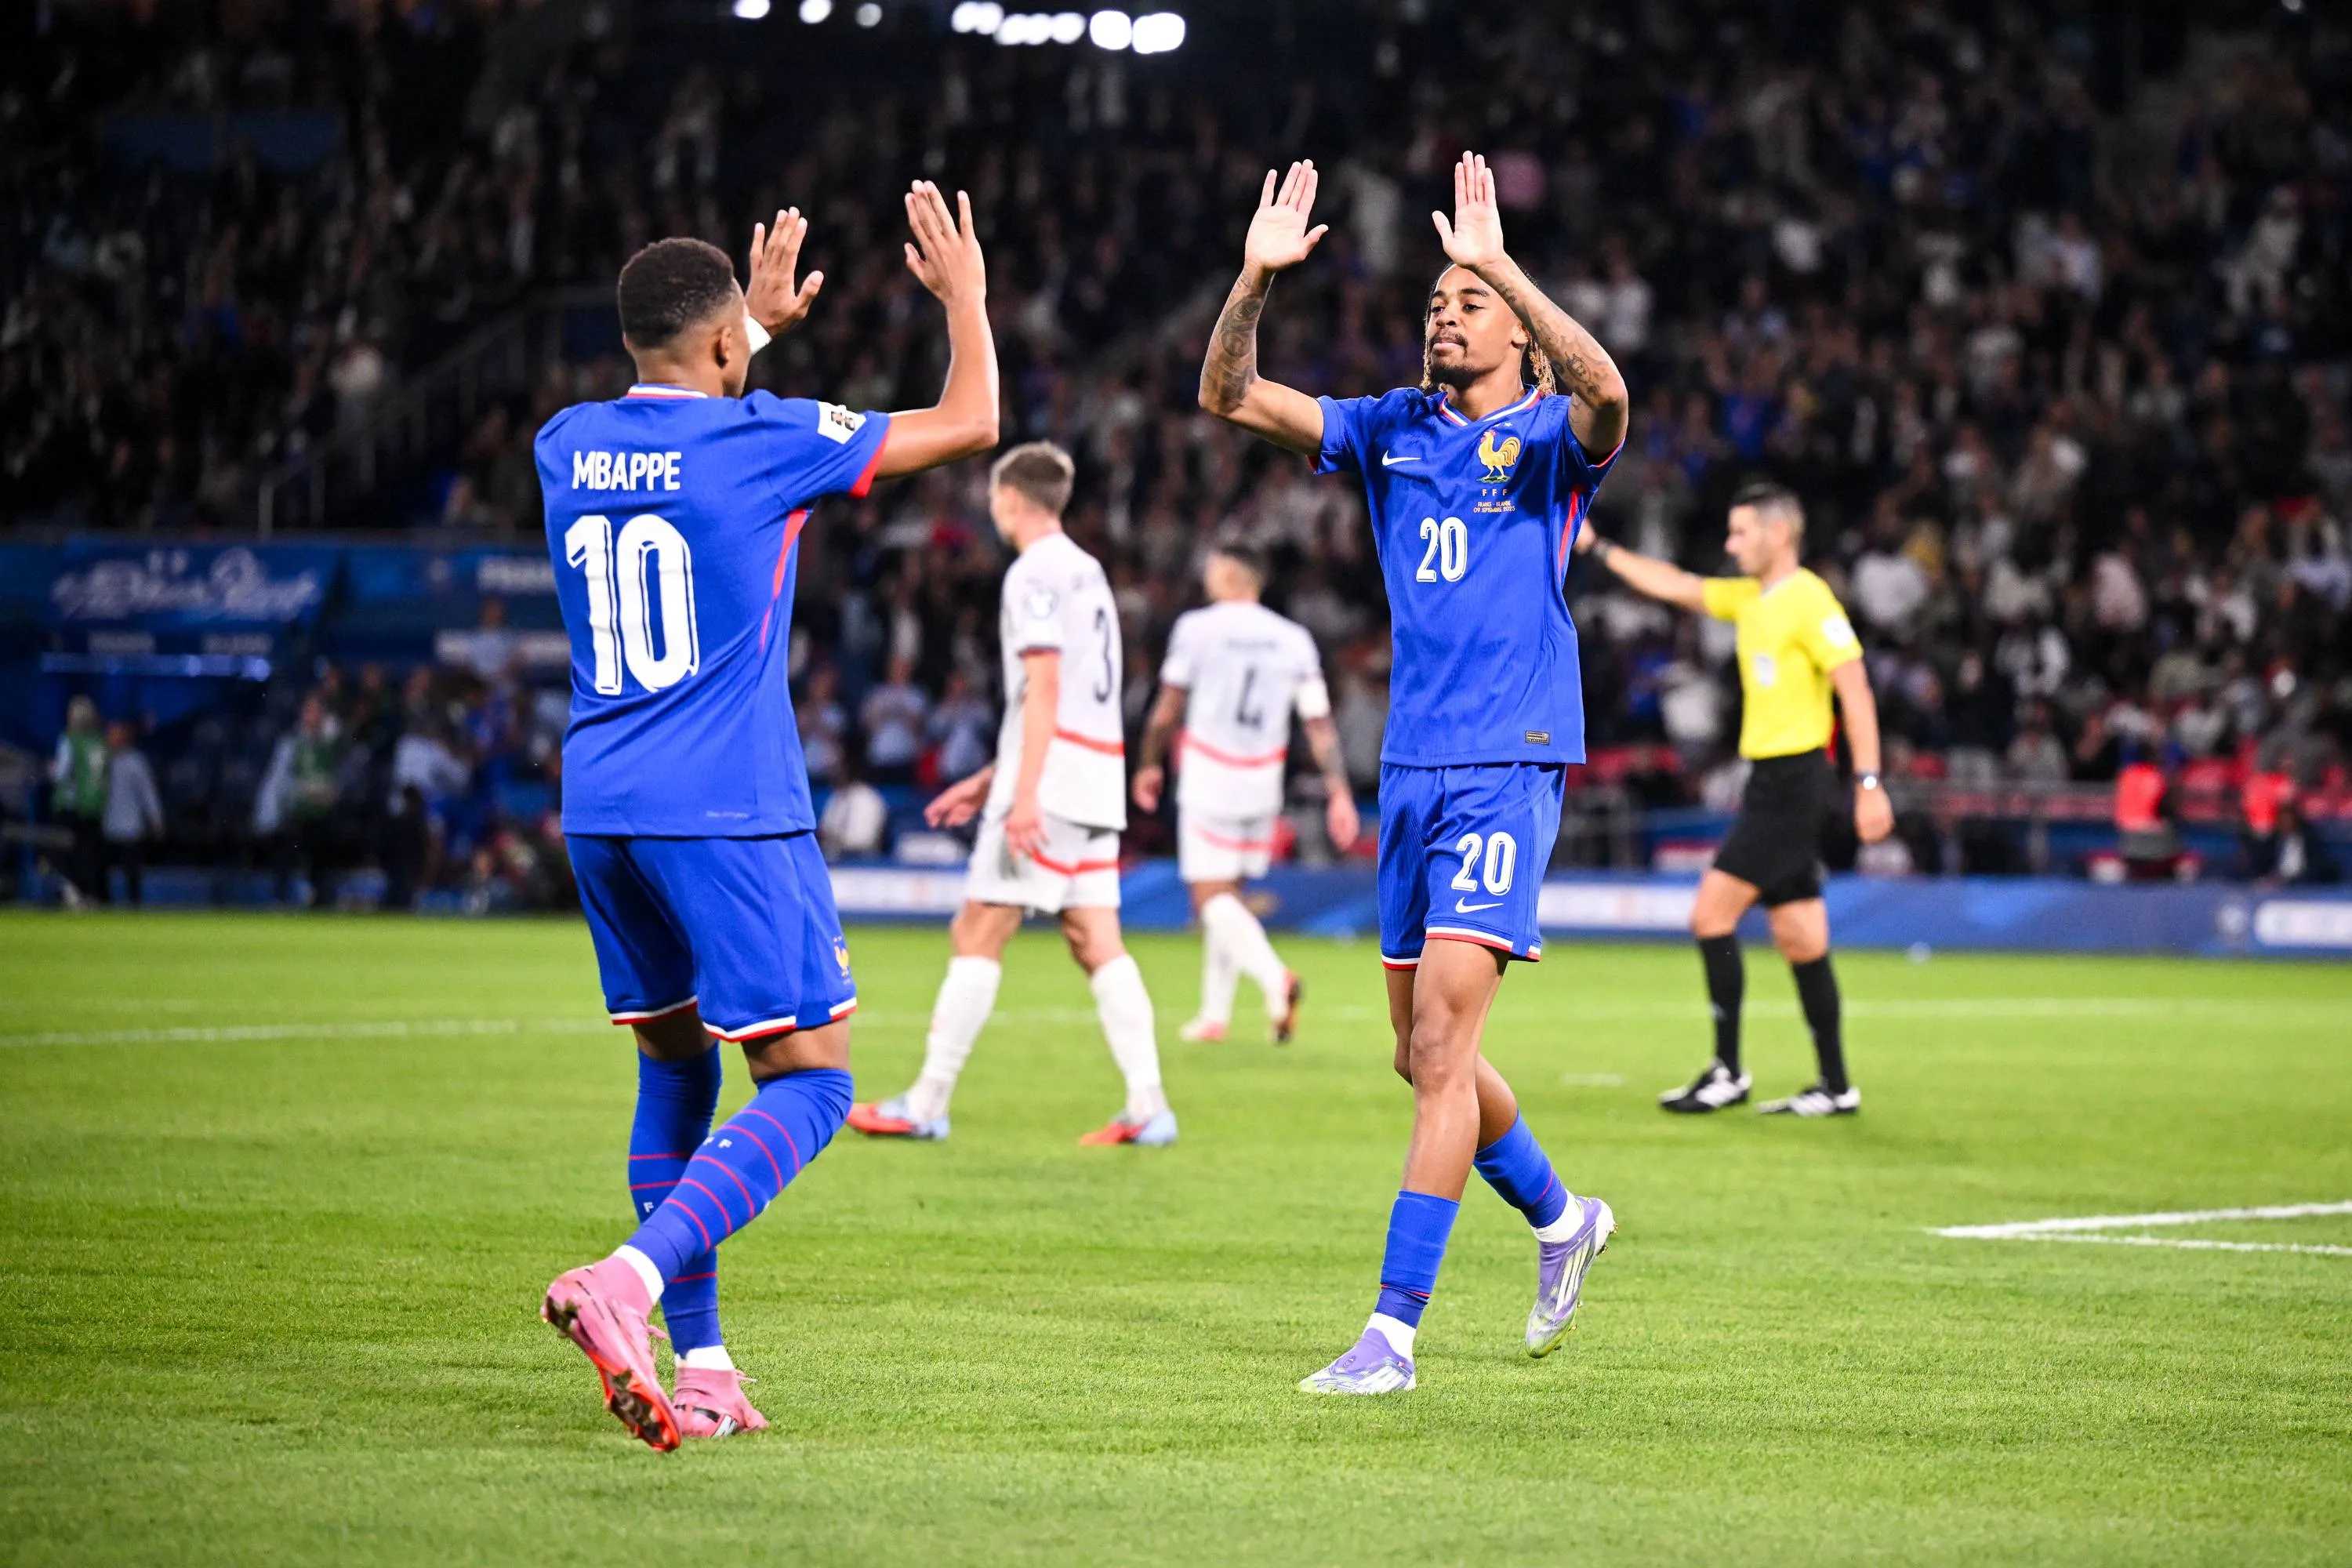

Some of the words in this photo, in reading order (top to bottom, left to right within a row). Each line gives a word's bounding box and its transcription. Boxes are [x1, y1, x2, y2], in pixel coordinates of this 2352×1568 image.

[572, 451, 681, 491] MBAPPE
[1416, 517, 1468, 582] 20
[564, 514, 699, 695] 10
[1093, 608, 1113, 704] 3
[1451, 831, 1516, 895] 20
